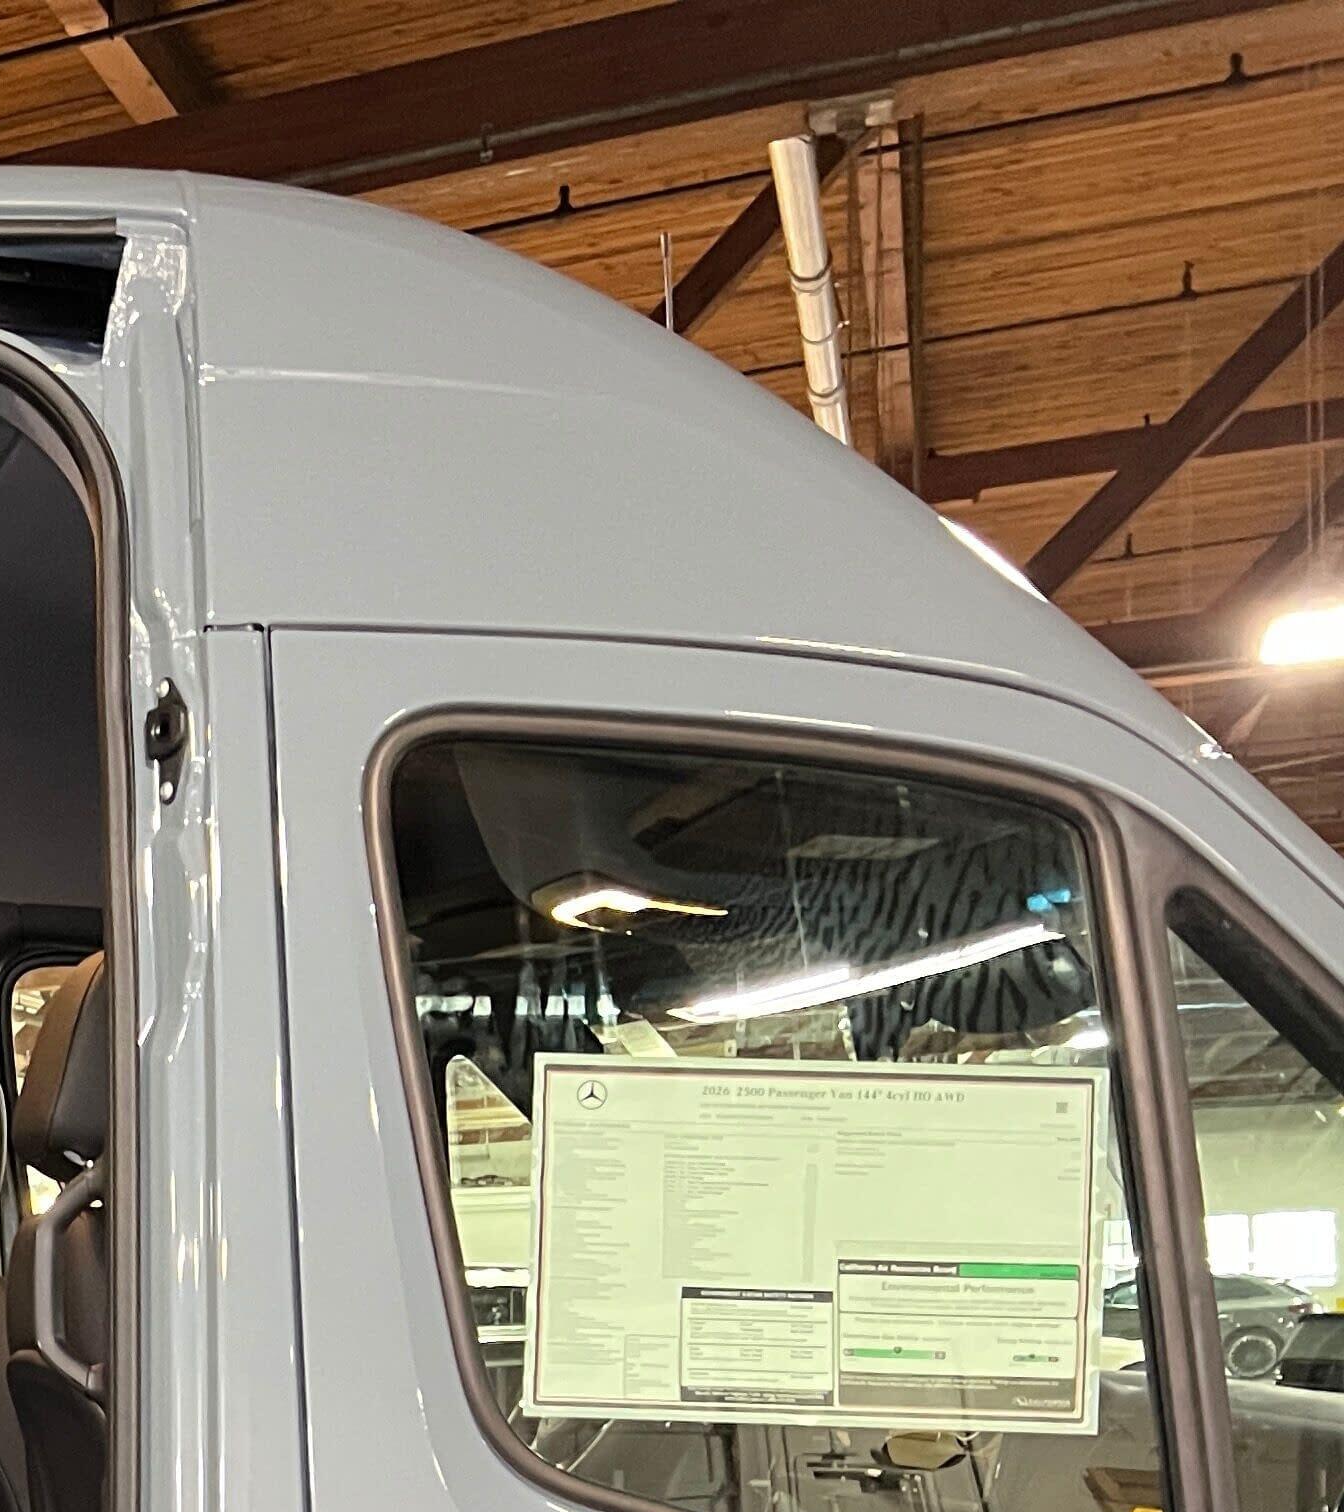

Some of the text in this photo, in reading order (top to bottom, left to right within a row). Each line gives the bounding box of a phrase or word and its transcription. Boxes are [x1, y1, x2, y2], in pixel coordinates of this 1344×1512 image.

[702, 1085, 730, 1096] 2026
[736, 1086, 766, 1097] 2500
[768, 1087, 827, 1101] Passenger
[831, 1088, 853, 1100] Van
